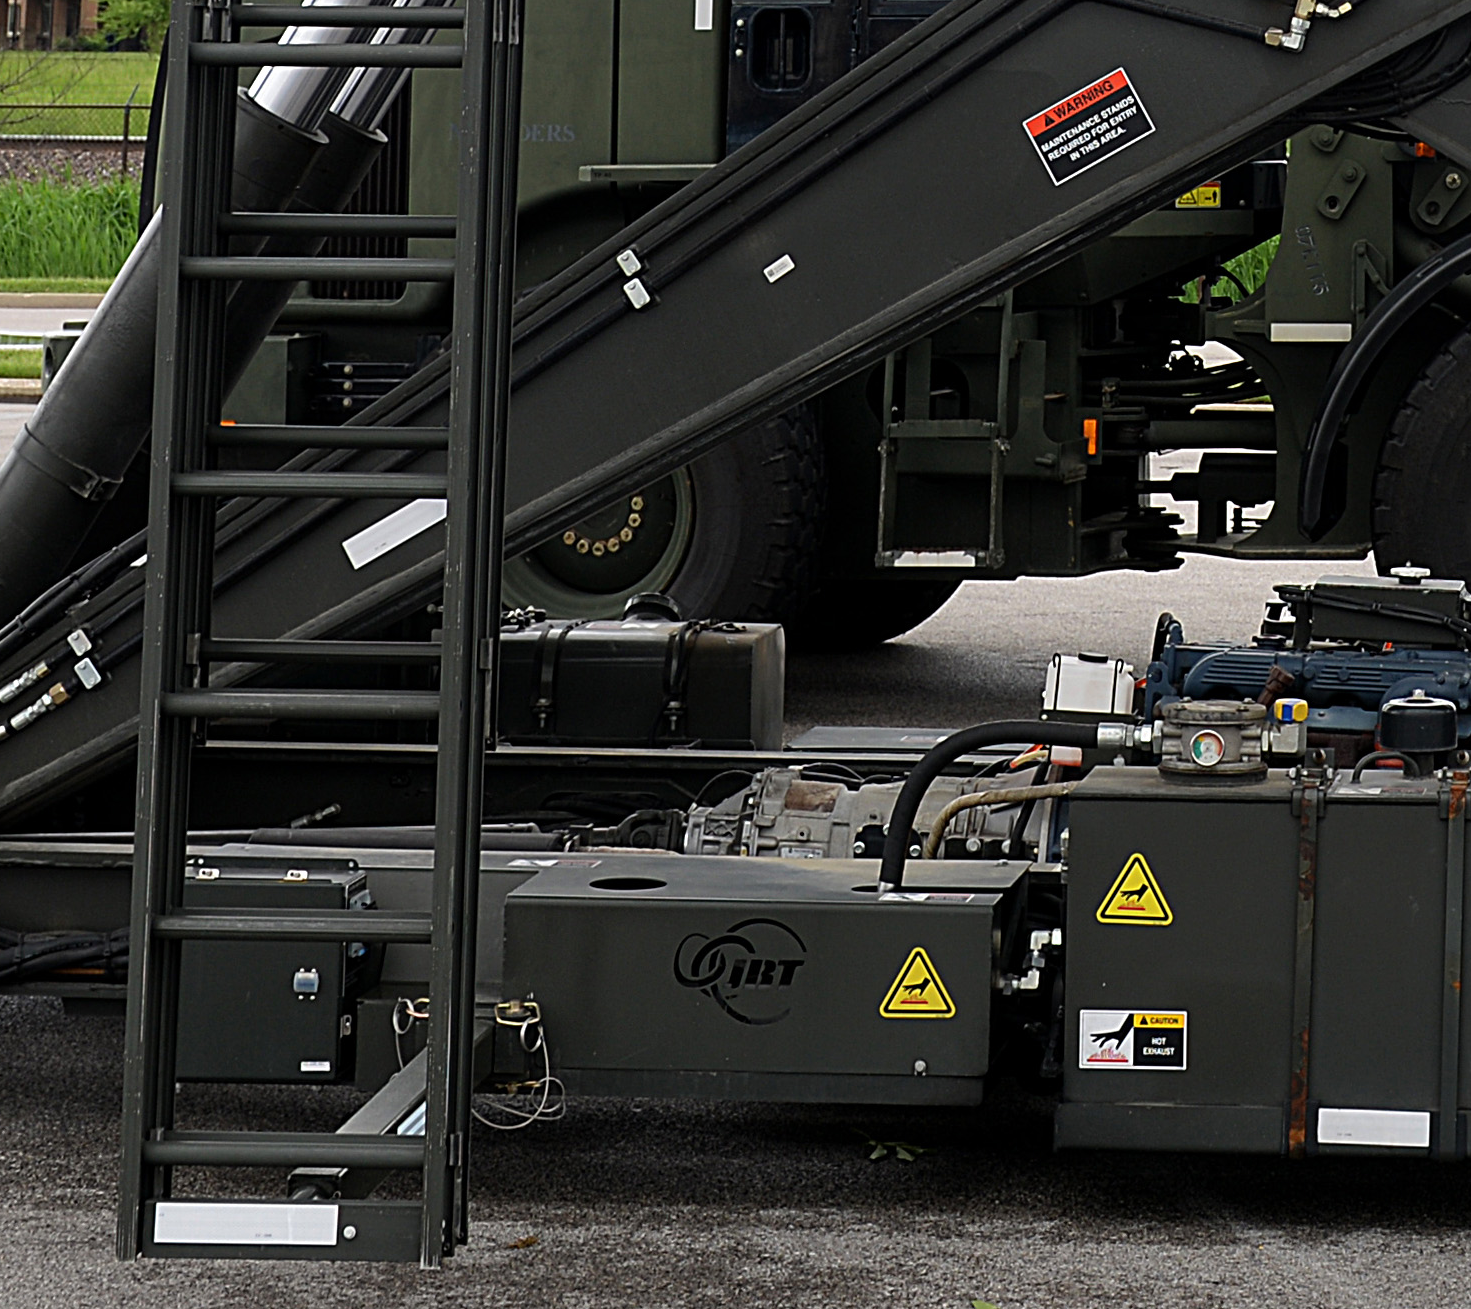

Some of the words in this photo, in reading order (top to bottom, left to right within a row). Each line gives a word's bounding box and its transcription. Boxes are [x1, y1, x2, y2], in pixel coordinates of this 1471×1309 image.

[1053, 80, 1115, 120] WARNING
[1040, 112, 1102, 153] MAINTENANCE
[1100, 95, 1135, 120] STANDS
[1047, 133, 1092, 162] REQUIRED
[1091, 122, 1110, 138] FOR
[1109, 105, 1138, 128] ENTRY
[1069, 150, 1081, 162] IN
[1079, 139, 1101, 156] THIS
[1149, 1017, 1179, 1027] CAUTION
[1142, 1047, 1175, 1057] EXHAUST
[1151, 1037, 1167, 1047] HOT
